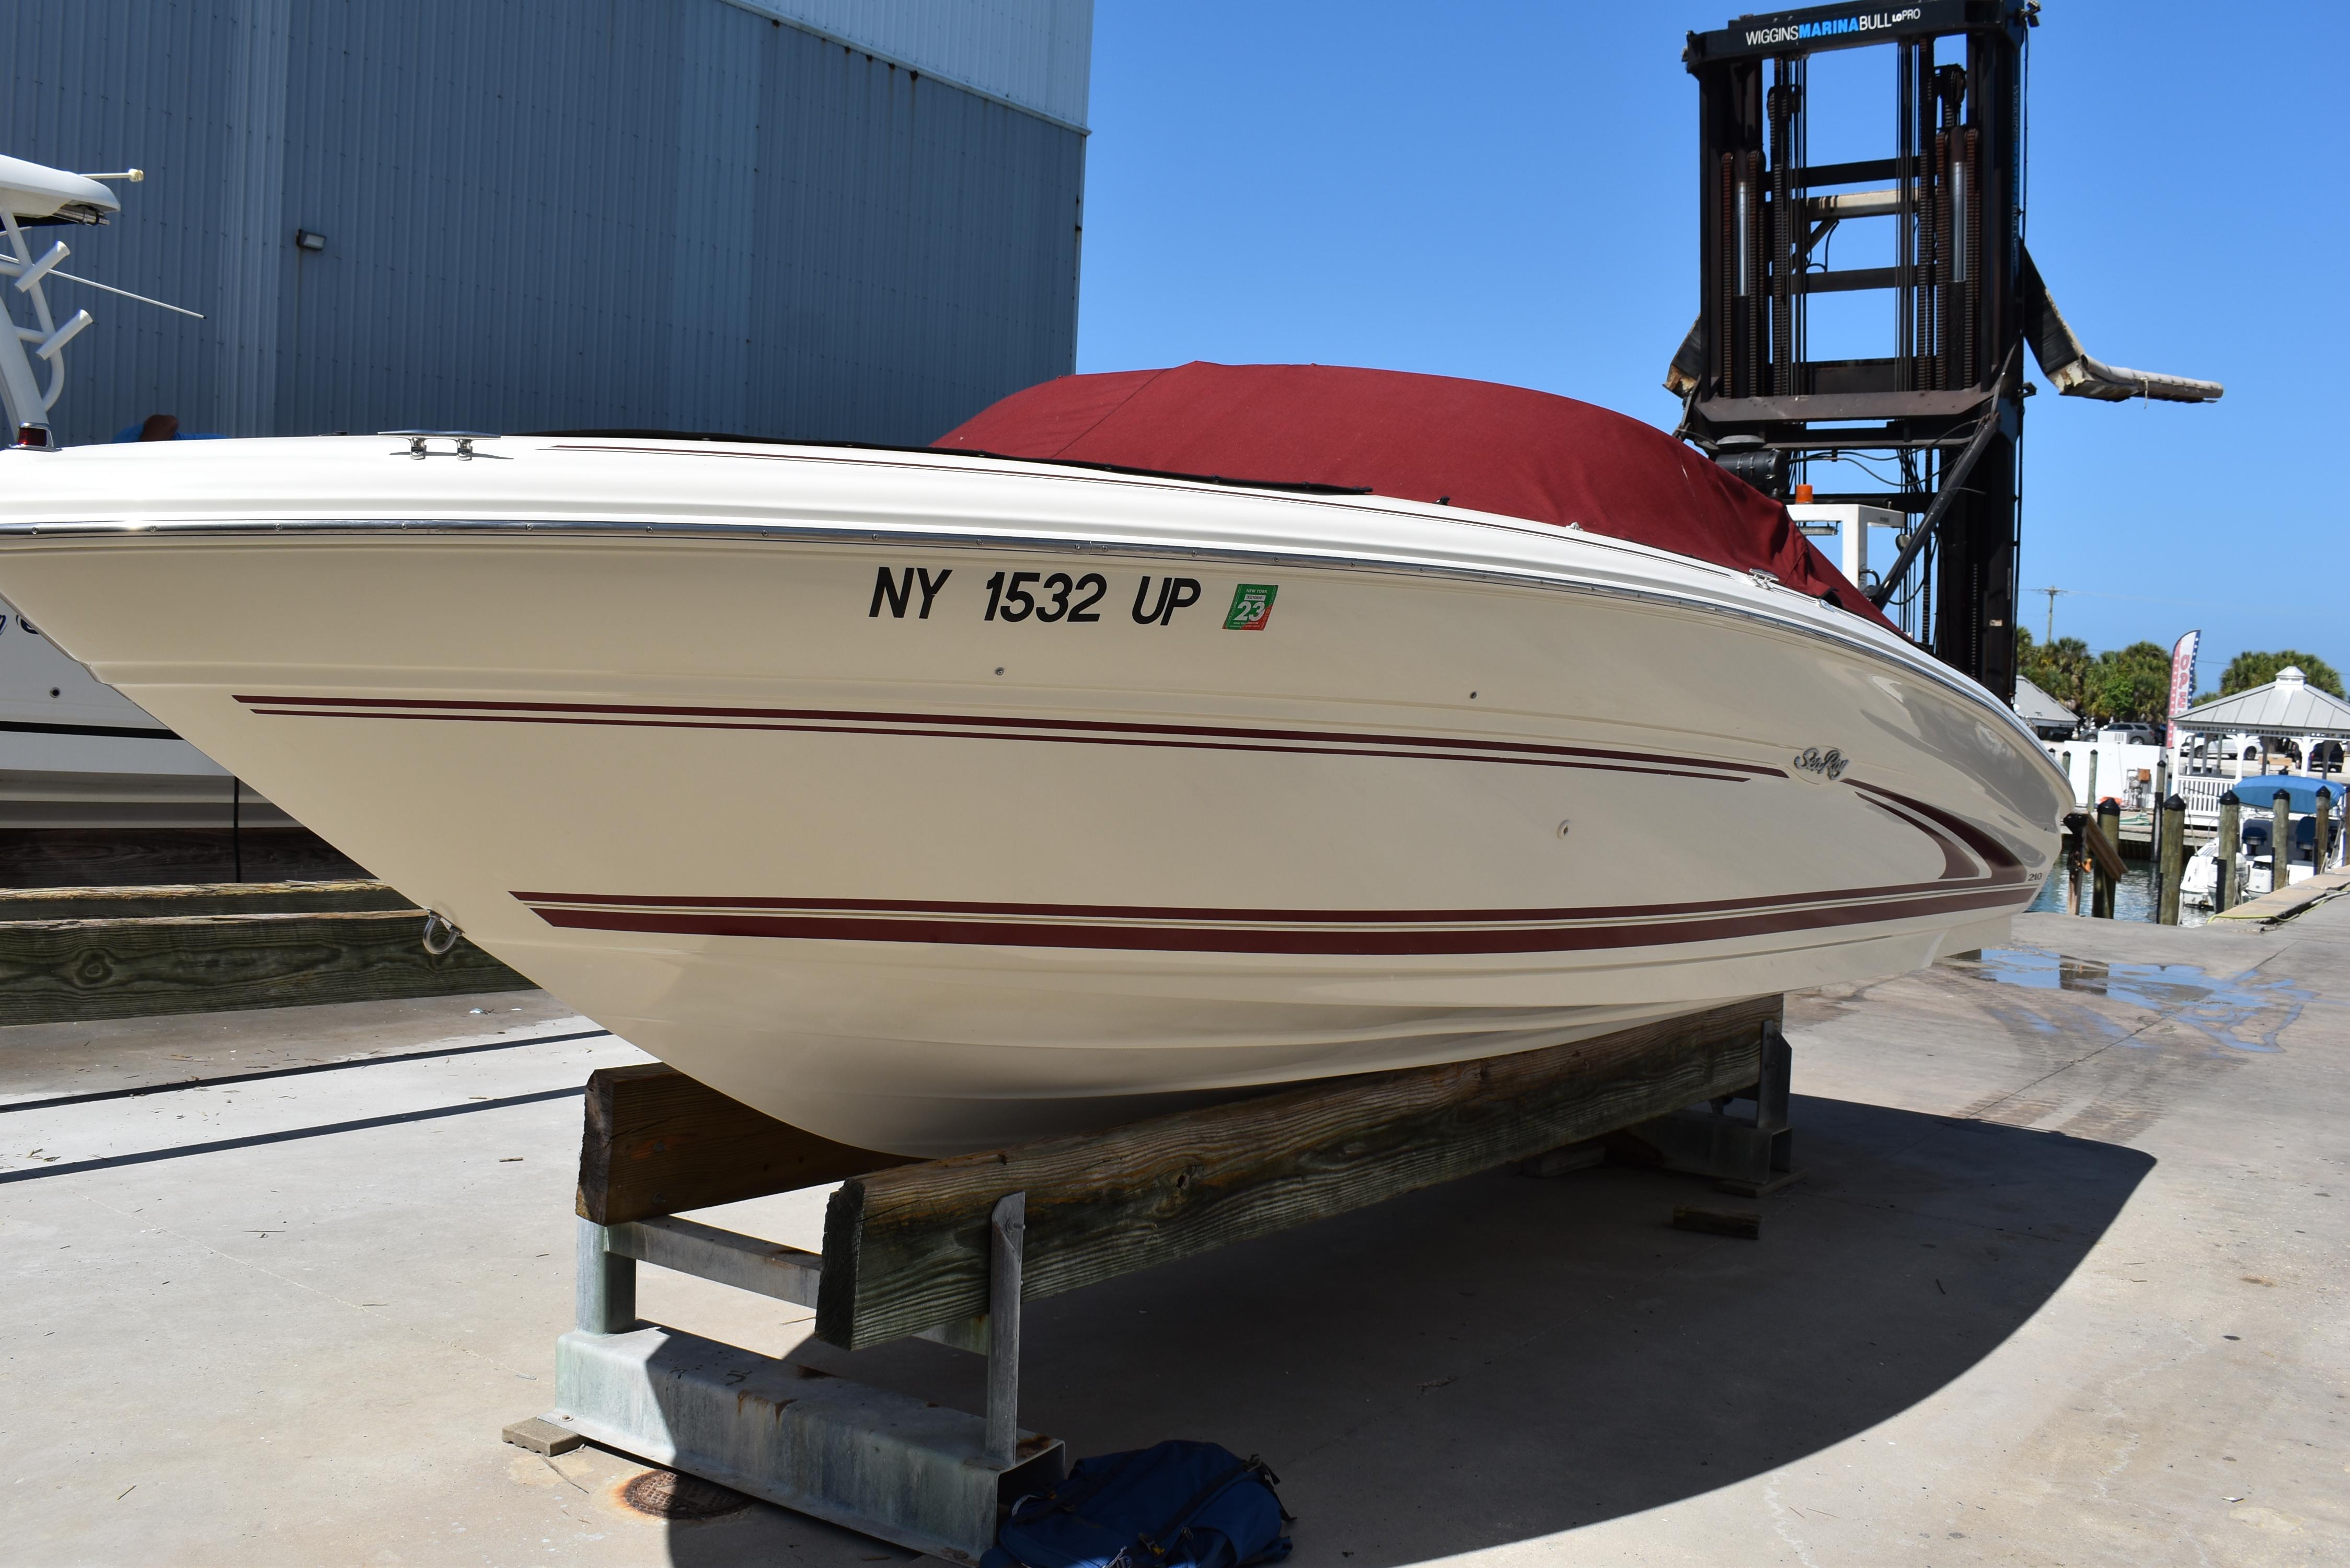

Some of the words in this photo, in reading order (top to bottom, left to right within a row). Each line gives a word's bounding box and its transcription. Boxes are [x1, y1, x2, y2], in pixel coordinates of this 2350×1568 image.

[869, 567, 953, 619] NY
[984, 571, 1108, 623] 1532
[1132, 575, 1201, 626] UP
[1233, 601, 1265, 621] 23
[2176, 654, 2190, 713] OPE
[2028, 872, 2042, 881] 210
